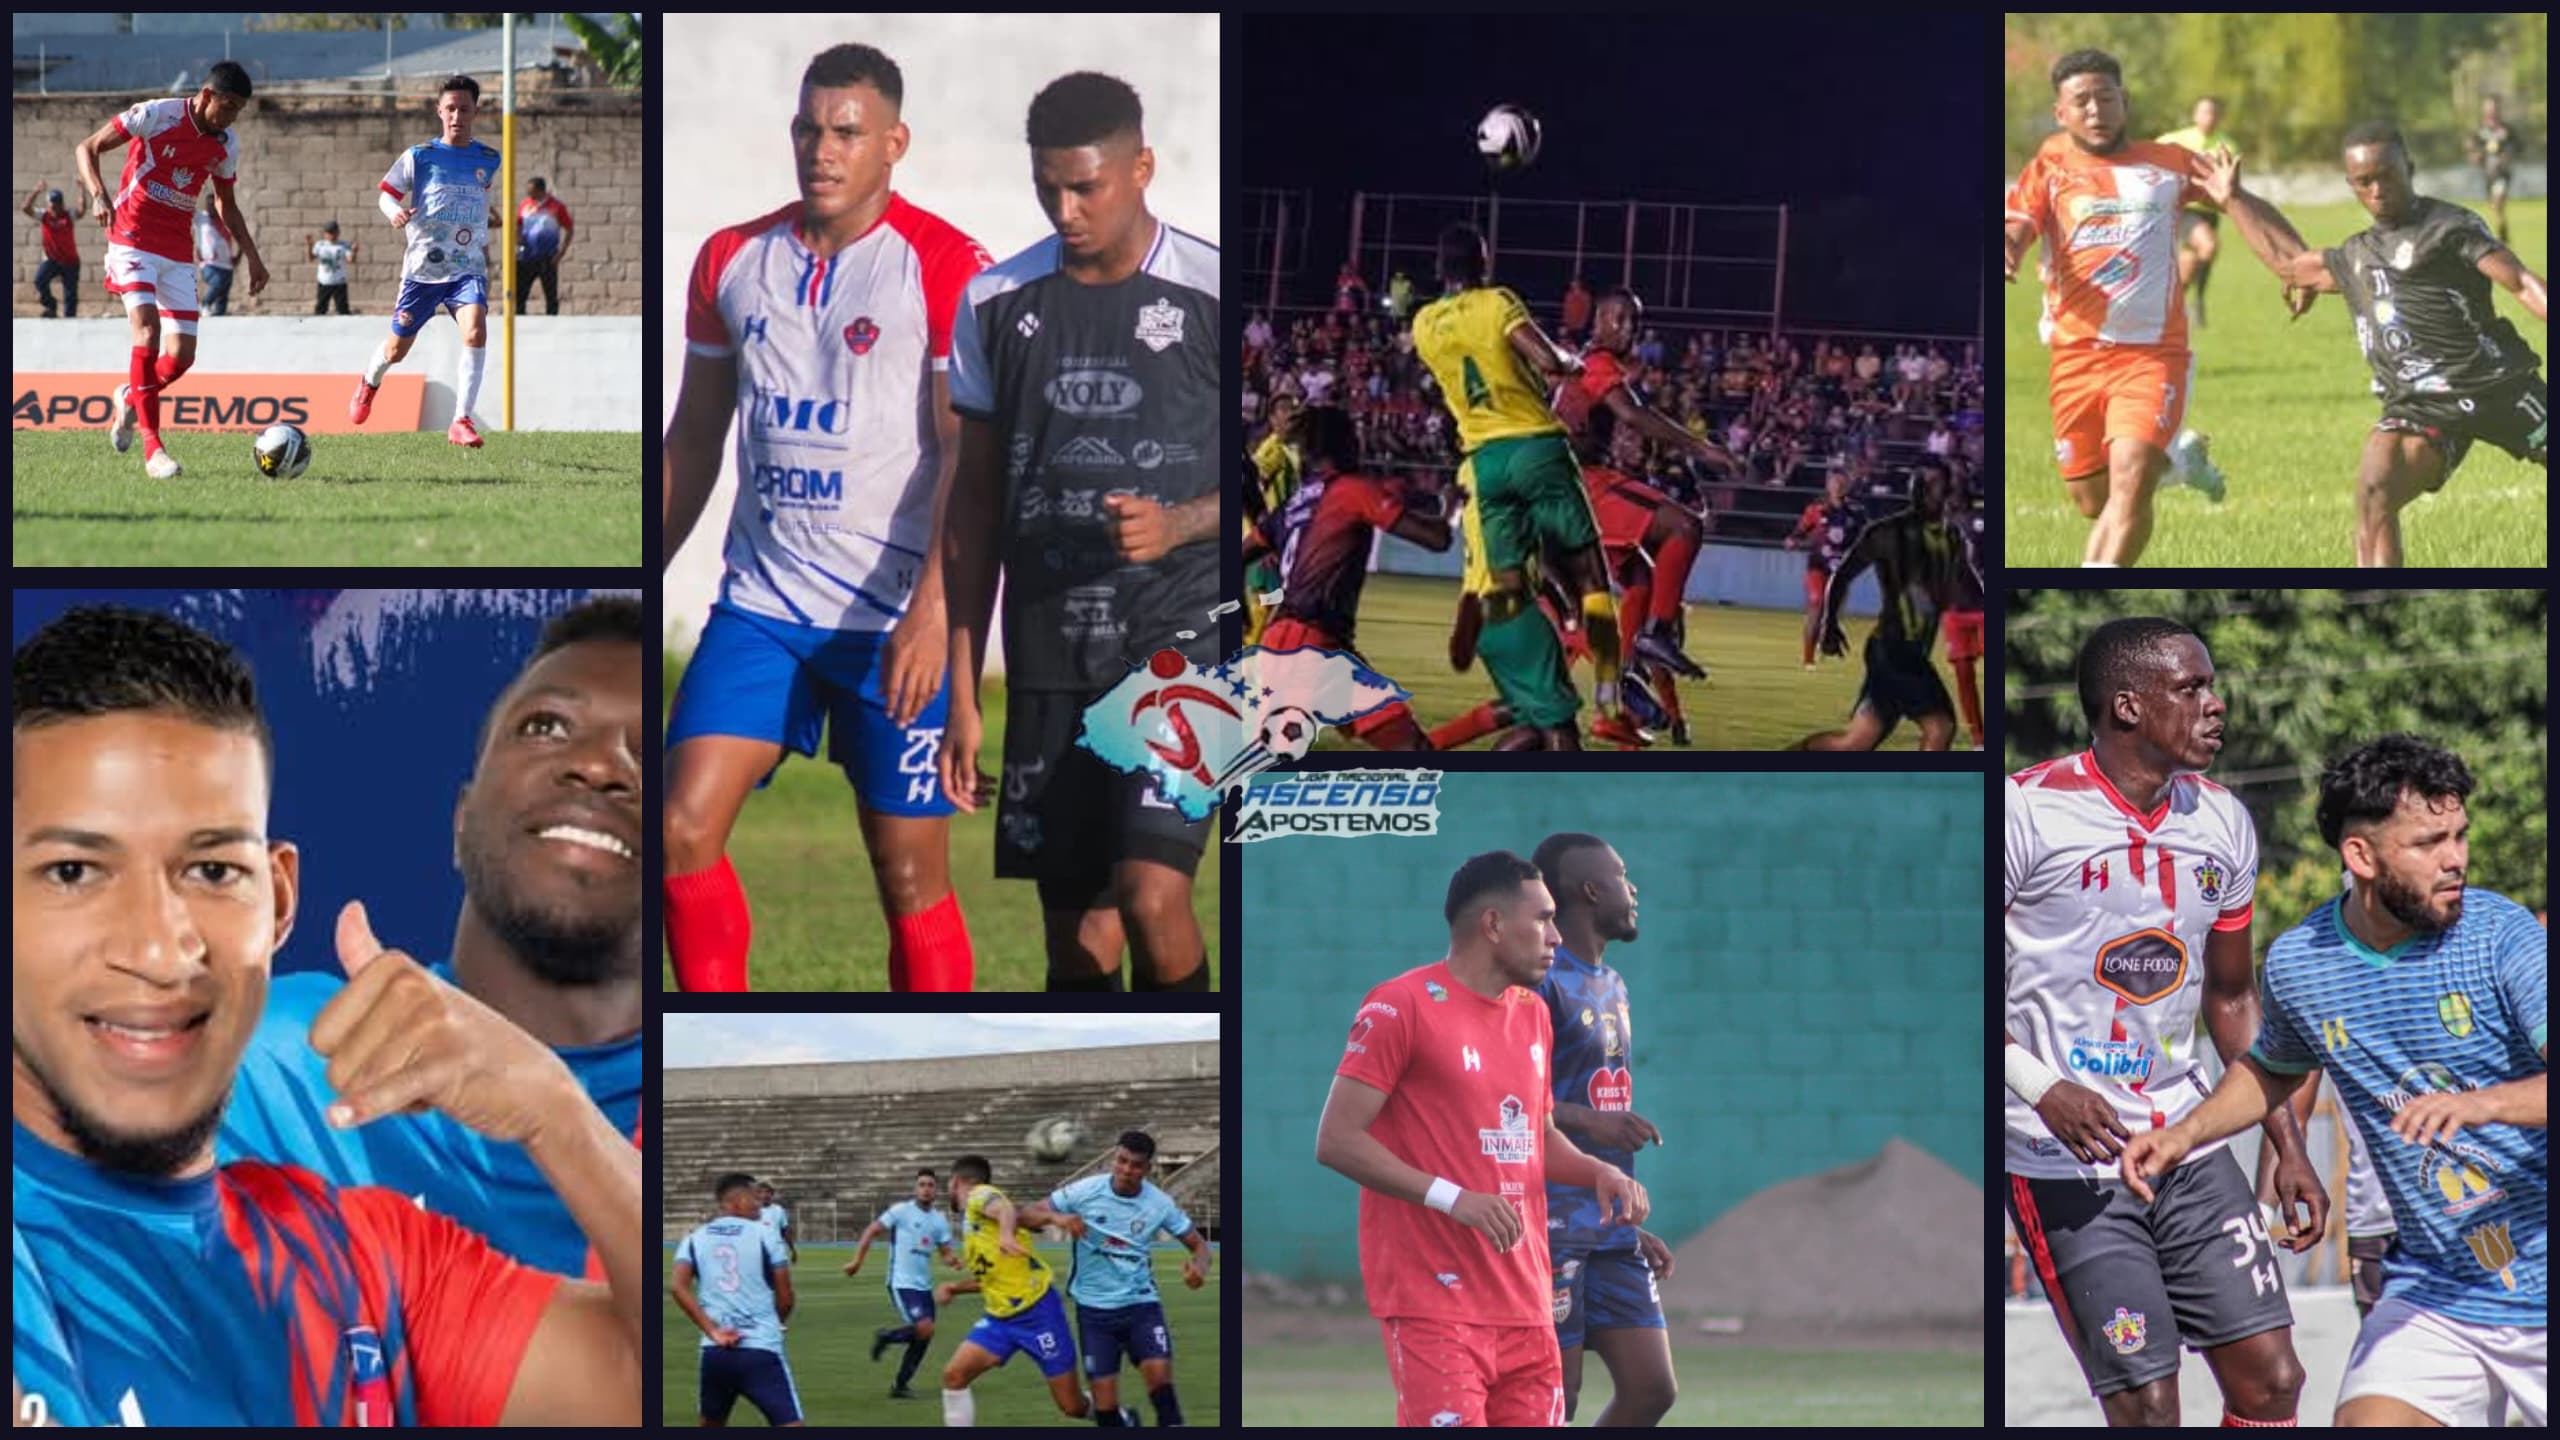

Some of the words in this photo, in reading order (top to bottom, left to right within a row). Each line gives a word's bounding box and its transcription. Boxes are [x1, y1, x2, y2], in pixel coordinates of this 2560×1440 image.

[13, 390, 309, 425] APOEMOS
[1056, 380, 1127, 407] YOLY
[2104, 957, 2140, 973] LONE
[2143, 957, 2179, 973] FOODS
[2222, 1212, 2276, 1268] 34
[713, 1245, 739, 1293] 3
